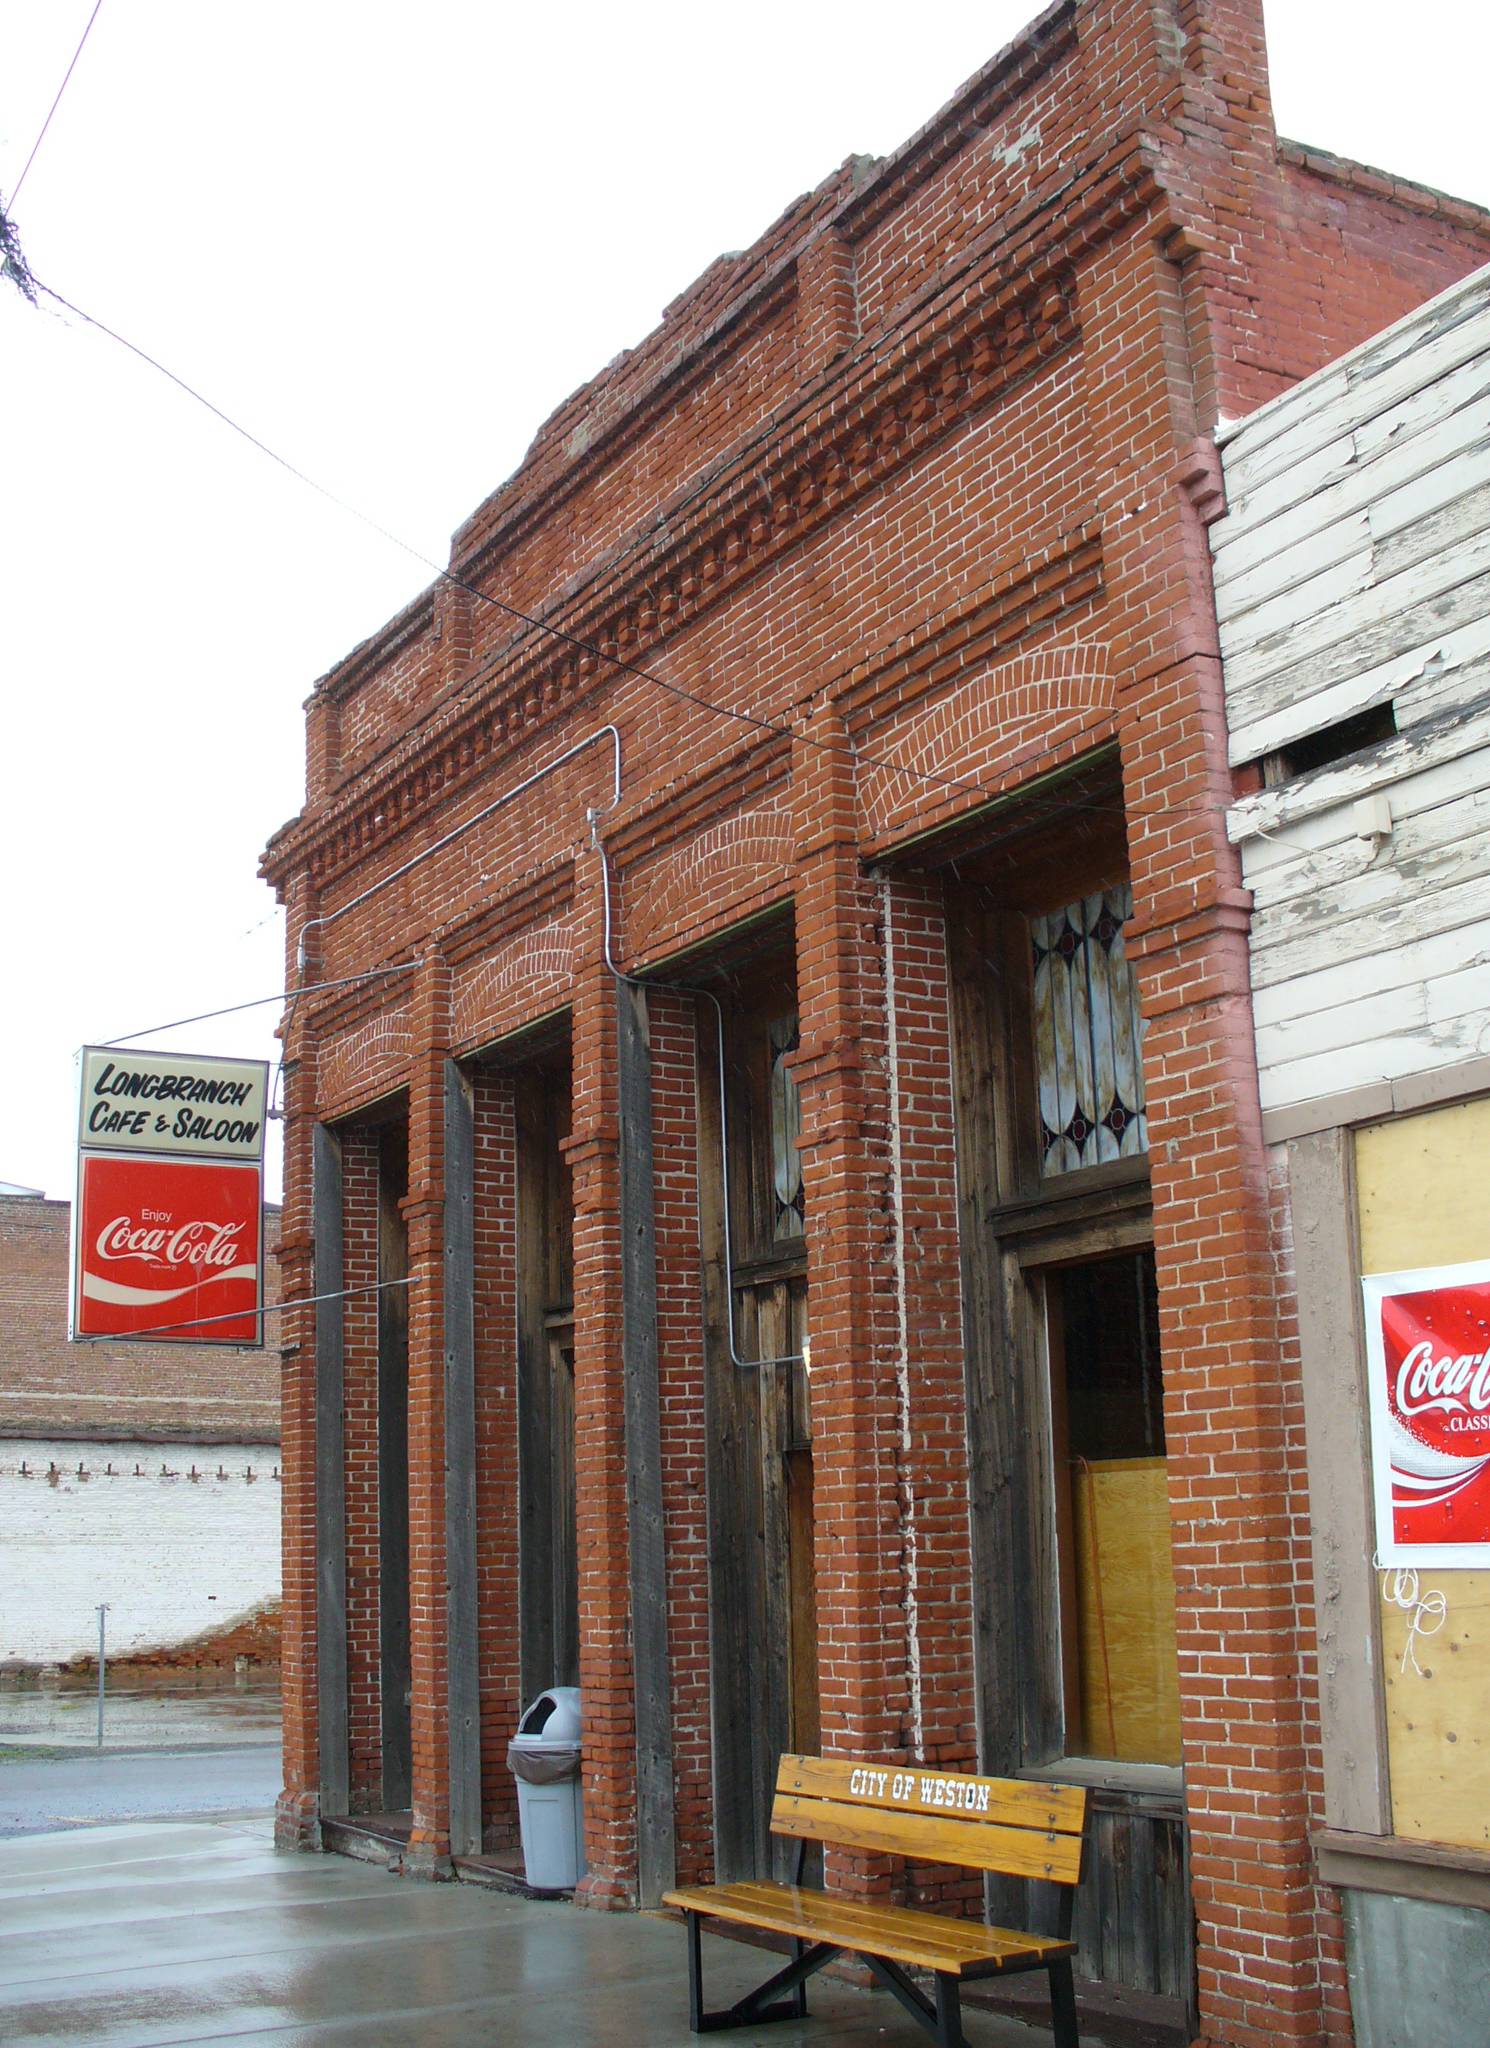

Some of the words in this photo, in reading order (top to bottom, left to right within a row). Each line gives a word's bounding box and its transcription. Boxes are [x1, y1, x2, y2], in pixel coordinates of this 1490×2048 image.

[94, 1063, 253, 1106] LONGBRANCH
[89, 1100, 151, 1135] CAFE
[154, 1114, 170, 1133] &
[172, 1107, 259, 1143] SALOON
[141, 1208, 172, 1222] Enjoy
[96, 1216, 246, 1265] Coca-Cola
[850, 1769, 888, 1797] CITY
[892, 1774, 915, 1800] OF
[920, 1776, 991, 1811] WESTON
